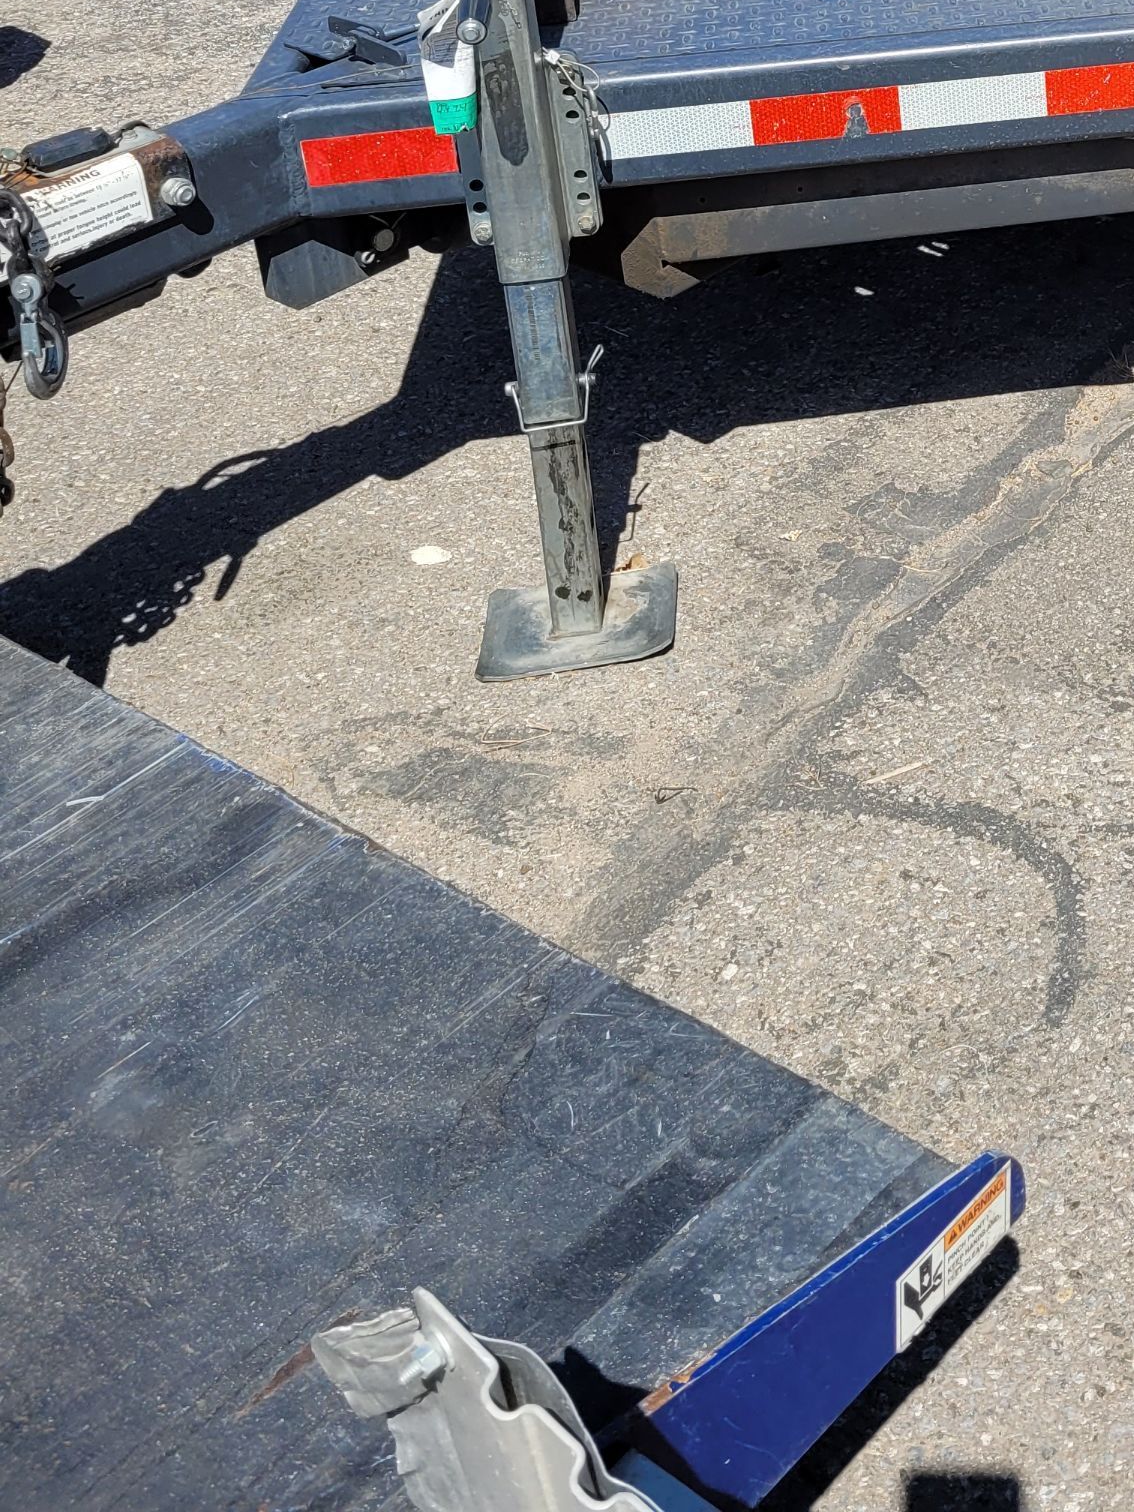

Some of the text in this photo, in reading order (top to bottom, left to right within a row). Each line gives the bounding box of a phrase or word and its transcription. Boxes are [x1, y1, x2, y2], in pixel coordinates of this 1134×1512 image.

[958, 1177, 1004, 1232] WARNING
[947, 1239, 967, 1265] PINCH
[947, 1252, 964, 1275] KEEP
[964, 1230, 985, 1254] HANDS
[963, 1241, 985, 1267] CLEAR
